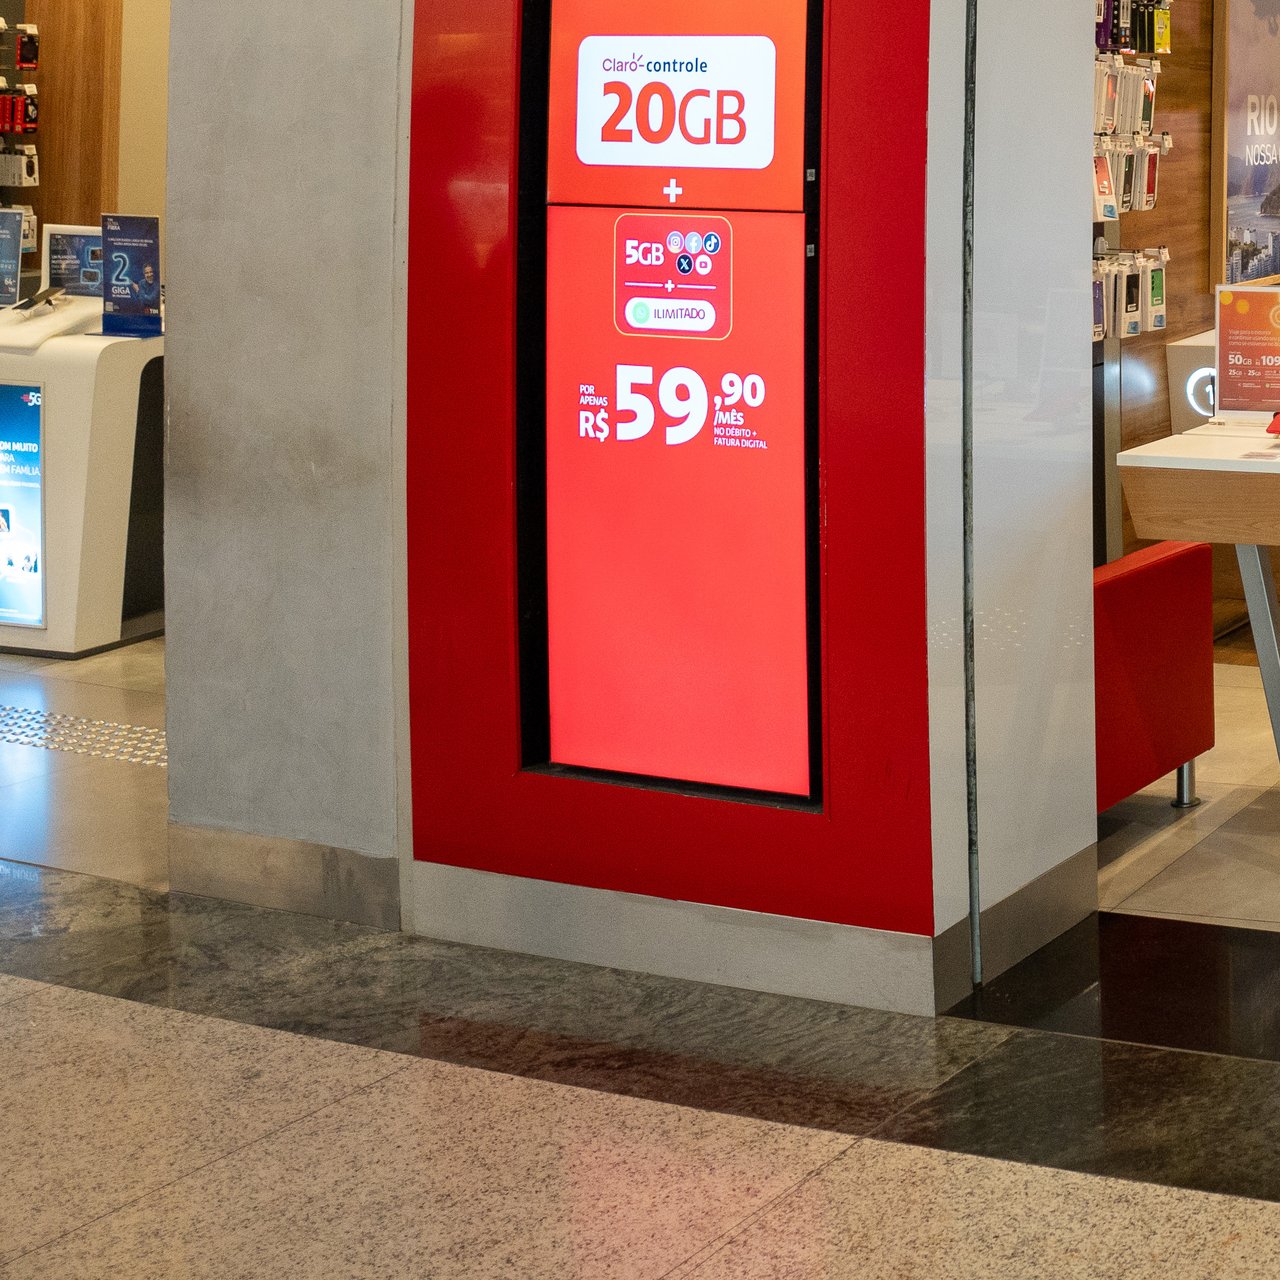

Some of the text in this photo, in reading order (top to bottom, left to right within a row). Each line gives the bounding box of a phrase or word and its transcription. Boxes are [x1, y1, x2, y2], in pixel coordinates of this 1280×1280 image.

[602, 57, 708, 73] Claro controle
[601, 80, 747, 146] 20GB
[1246, 95, 1278, 136] RIO
[1245, 144, 1278, 166] NOSSA
[625, 239, 665, 266] 5GB
[111, 252, 130, 285] 2
[111, 286, 131, 295] GIGA
[653, 307, 706, 320] ILIMITADO
[1228, 354, 1252, 366] 50GB
[579, 384, 594, 395] POR
[579, 395, 608, 407] APENAS
[579, 407, 610, 443] R$
[713, 426, 725, 436] NO
[725, 425, 751, 437] DÉBITO
[12, 441, 39, 453] MUITO
[713, 437, 768, 450] FATURA DIGITAL
